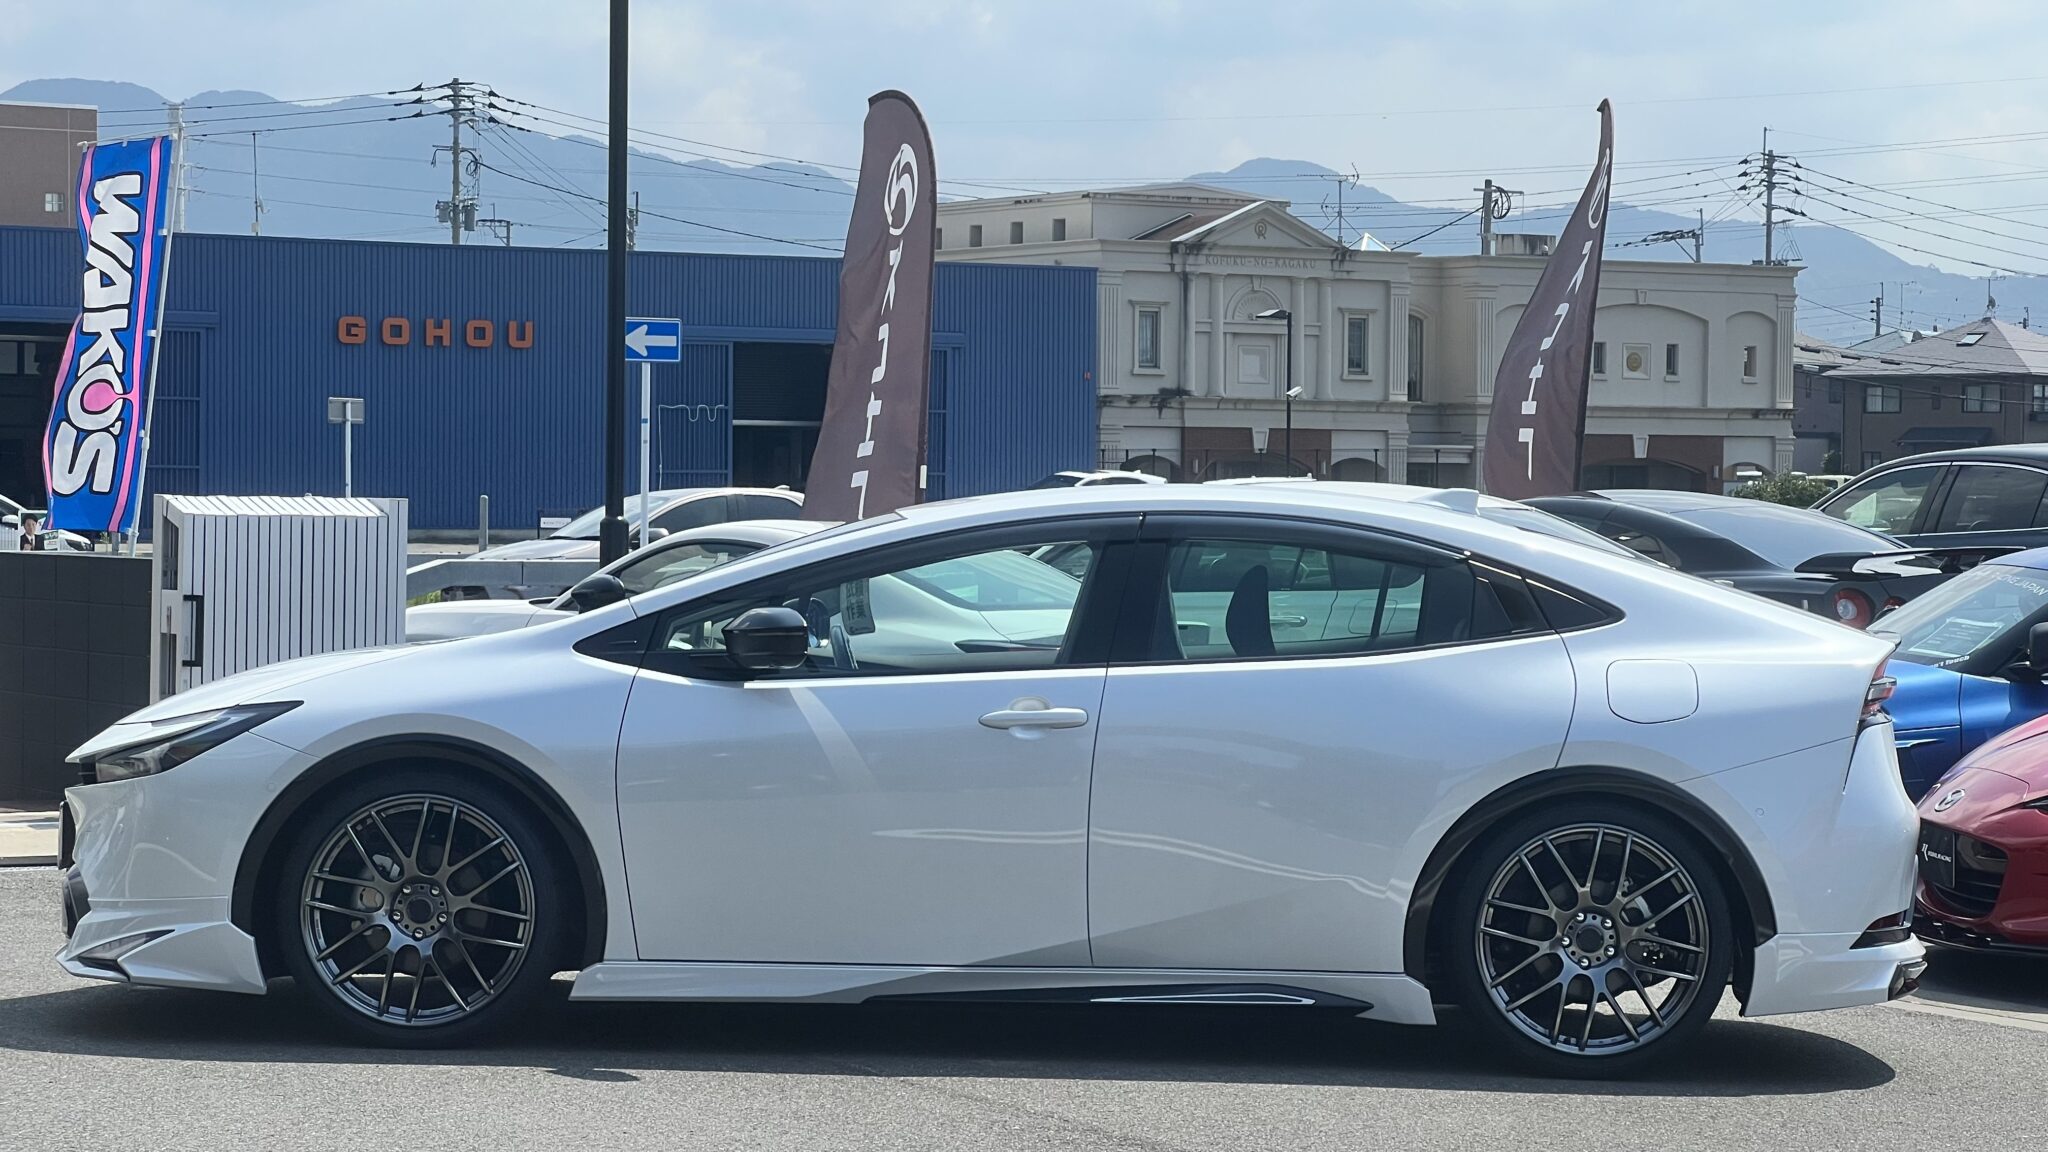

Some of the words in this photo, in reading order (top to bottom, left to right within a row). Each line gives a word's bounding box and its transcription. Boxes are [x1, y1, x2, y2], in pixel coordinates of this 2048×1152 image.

[1205, 254, 1317, 269] KOFUKU-NO-KAGAKU
[51, 173, 142, 496] WAKO'S
[338, 315, 534, 349] GOHOU
